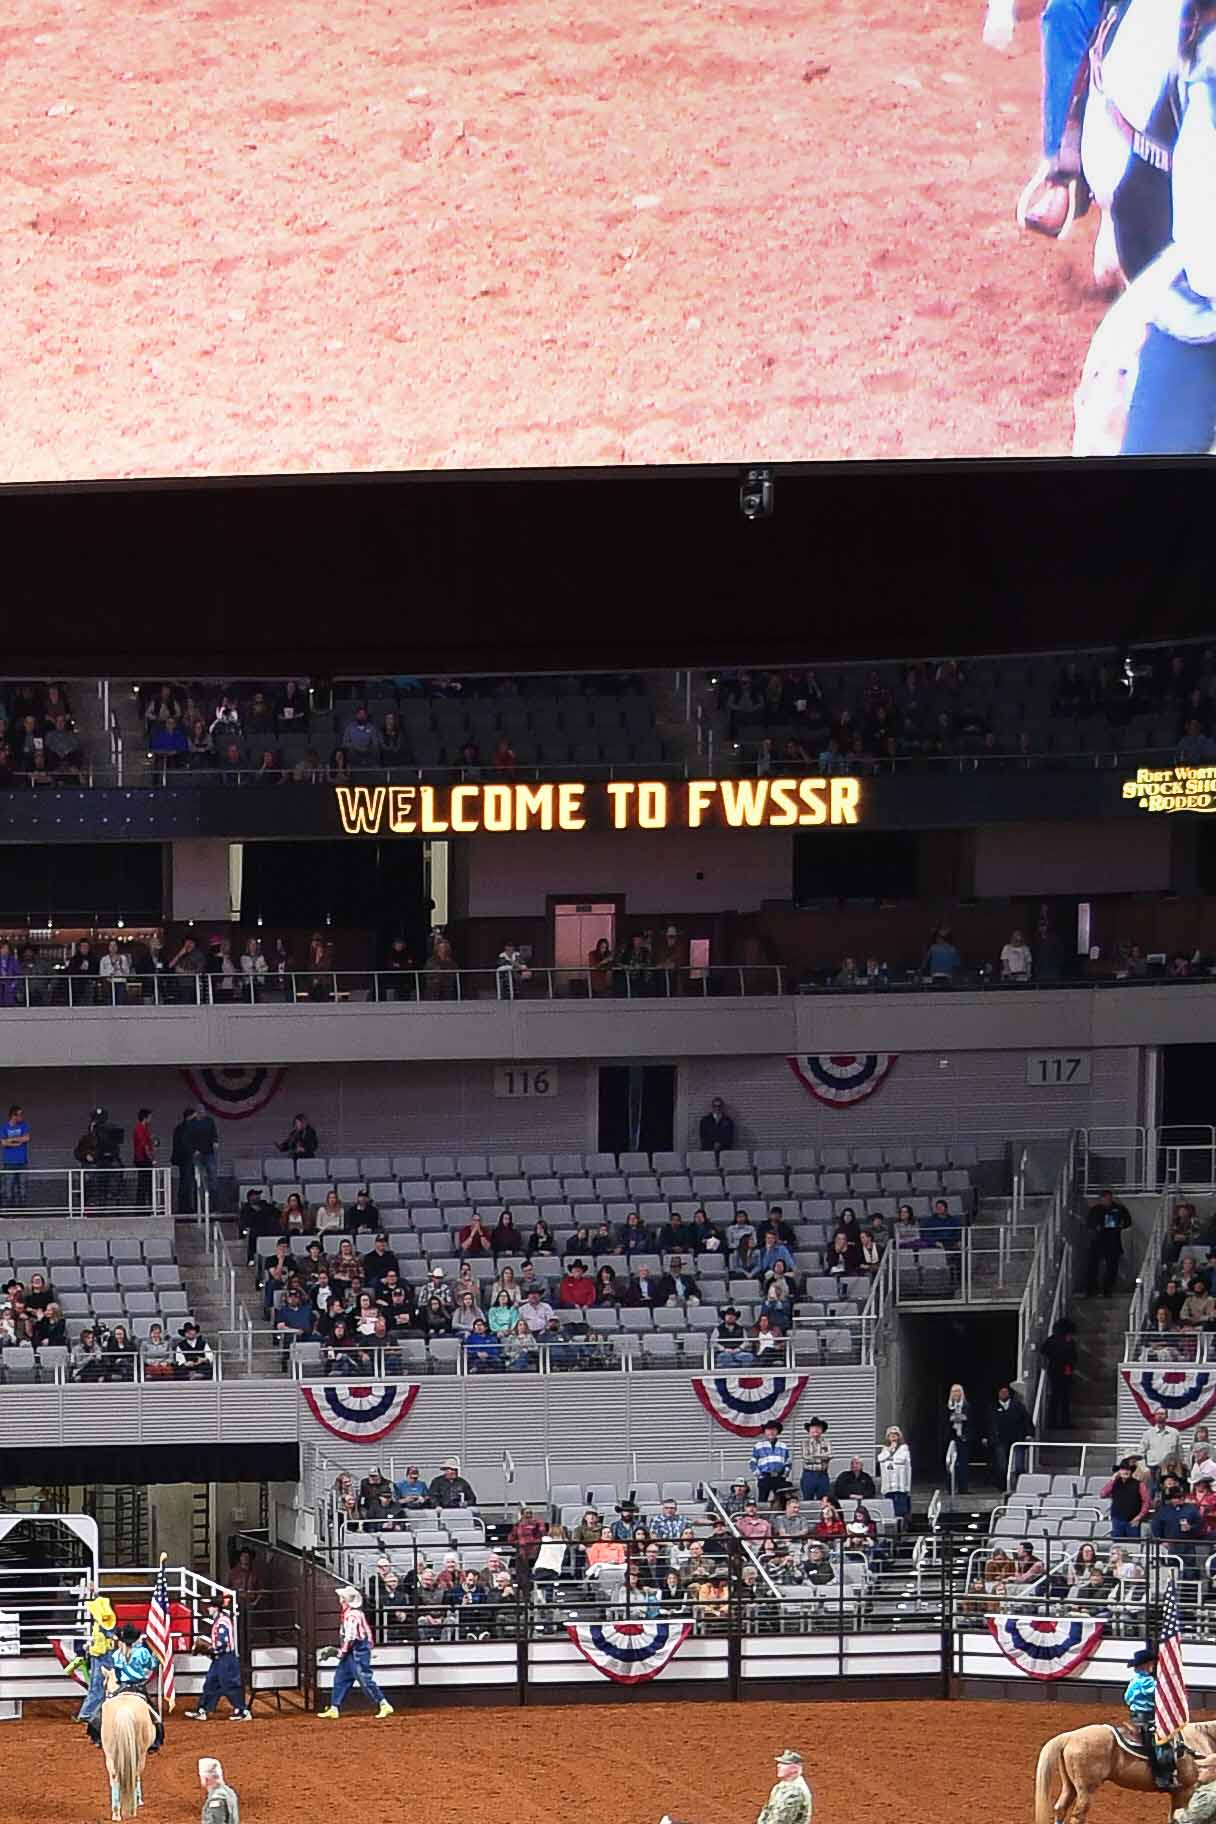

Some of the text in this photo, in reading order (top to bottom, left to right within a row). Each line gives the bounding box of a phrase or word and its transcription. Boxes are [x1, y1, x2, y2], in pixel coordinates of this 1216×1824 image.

[1136, 768, 1216, 784] FORT WORT
[1122, 782, 1184, 799] STOCK
[335, 777, 860, 834] WELCOME TO FWSSR
[1148, 795, 1211, 811] RODEO
[1037, 1058, 1081, 1081] 117
[504, 1071, 550, 1094] 116
